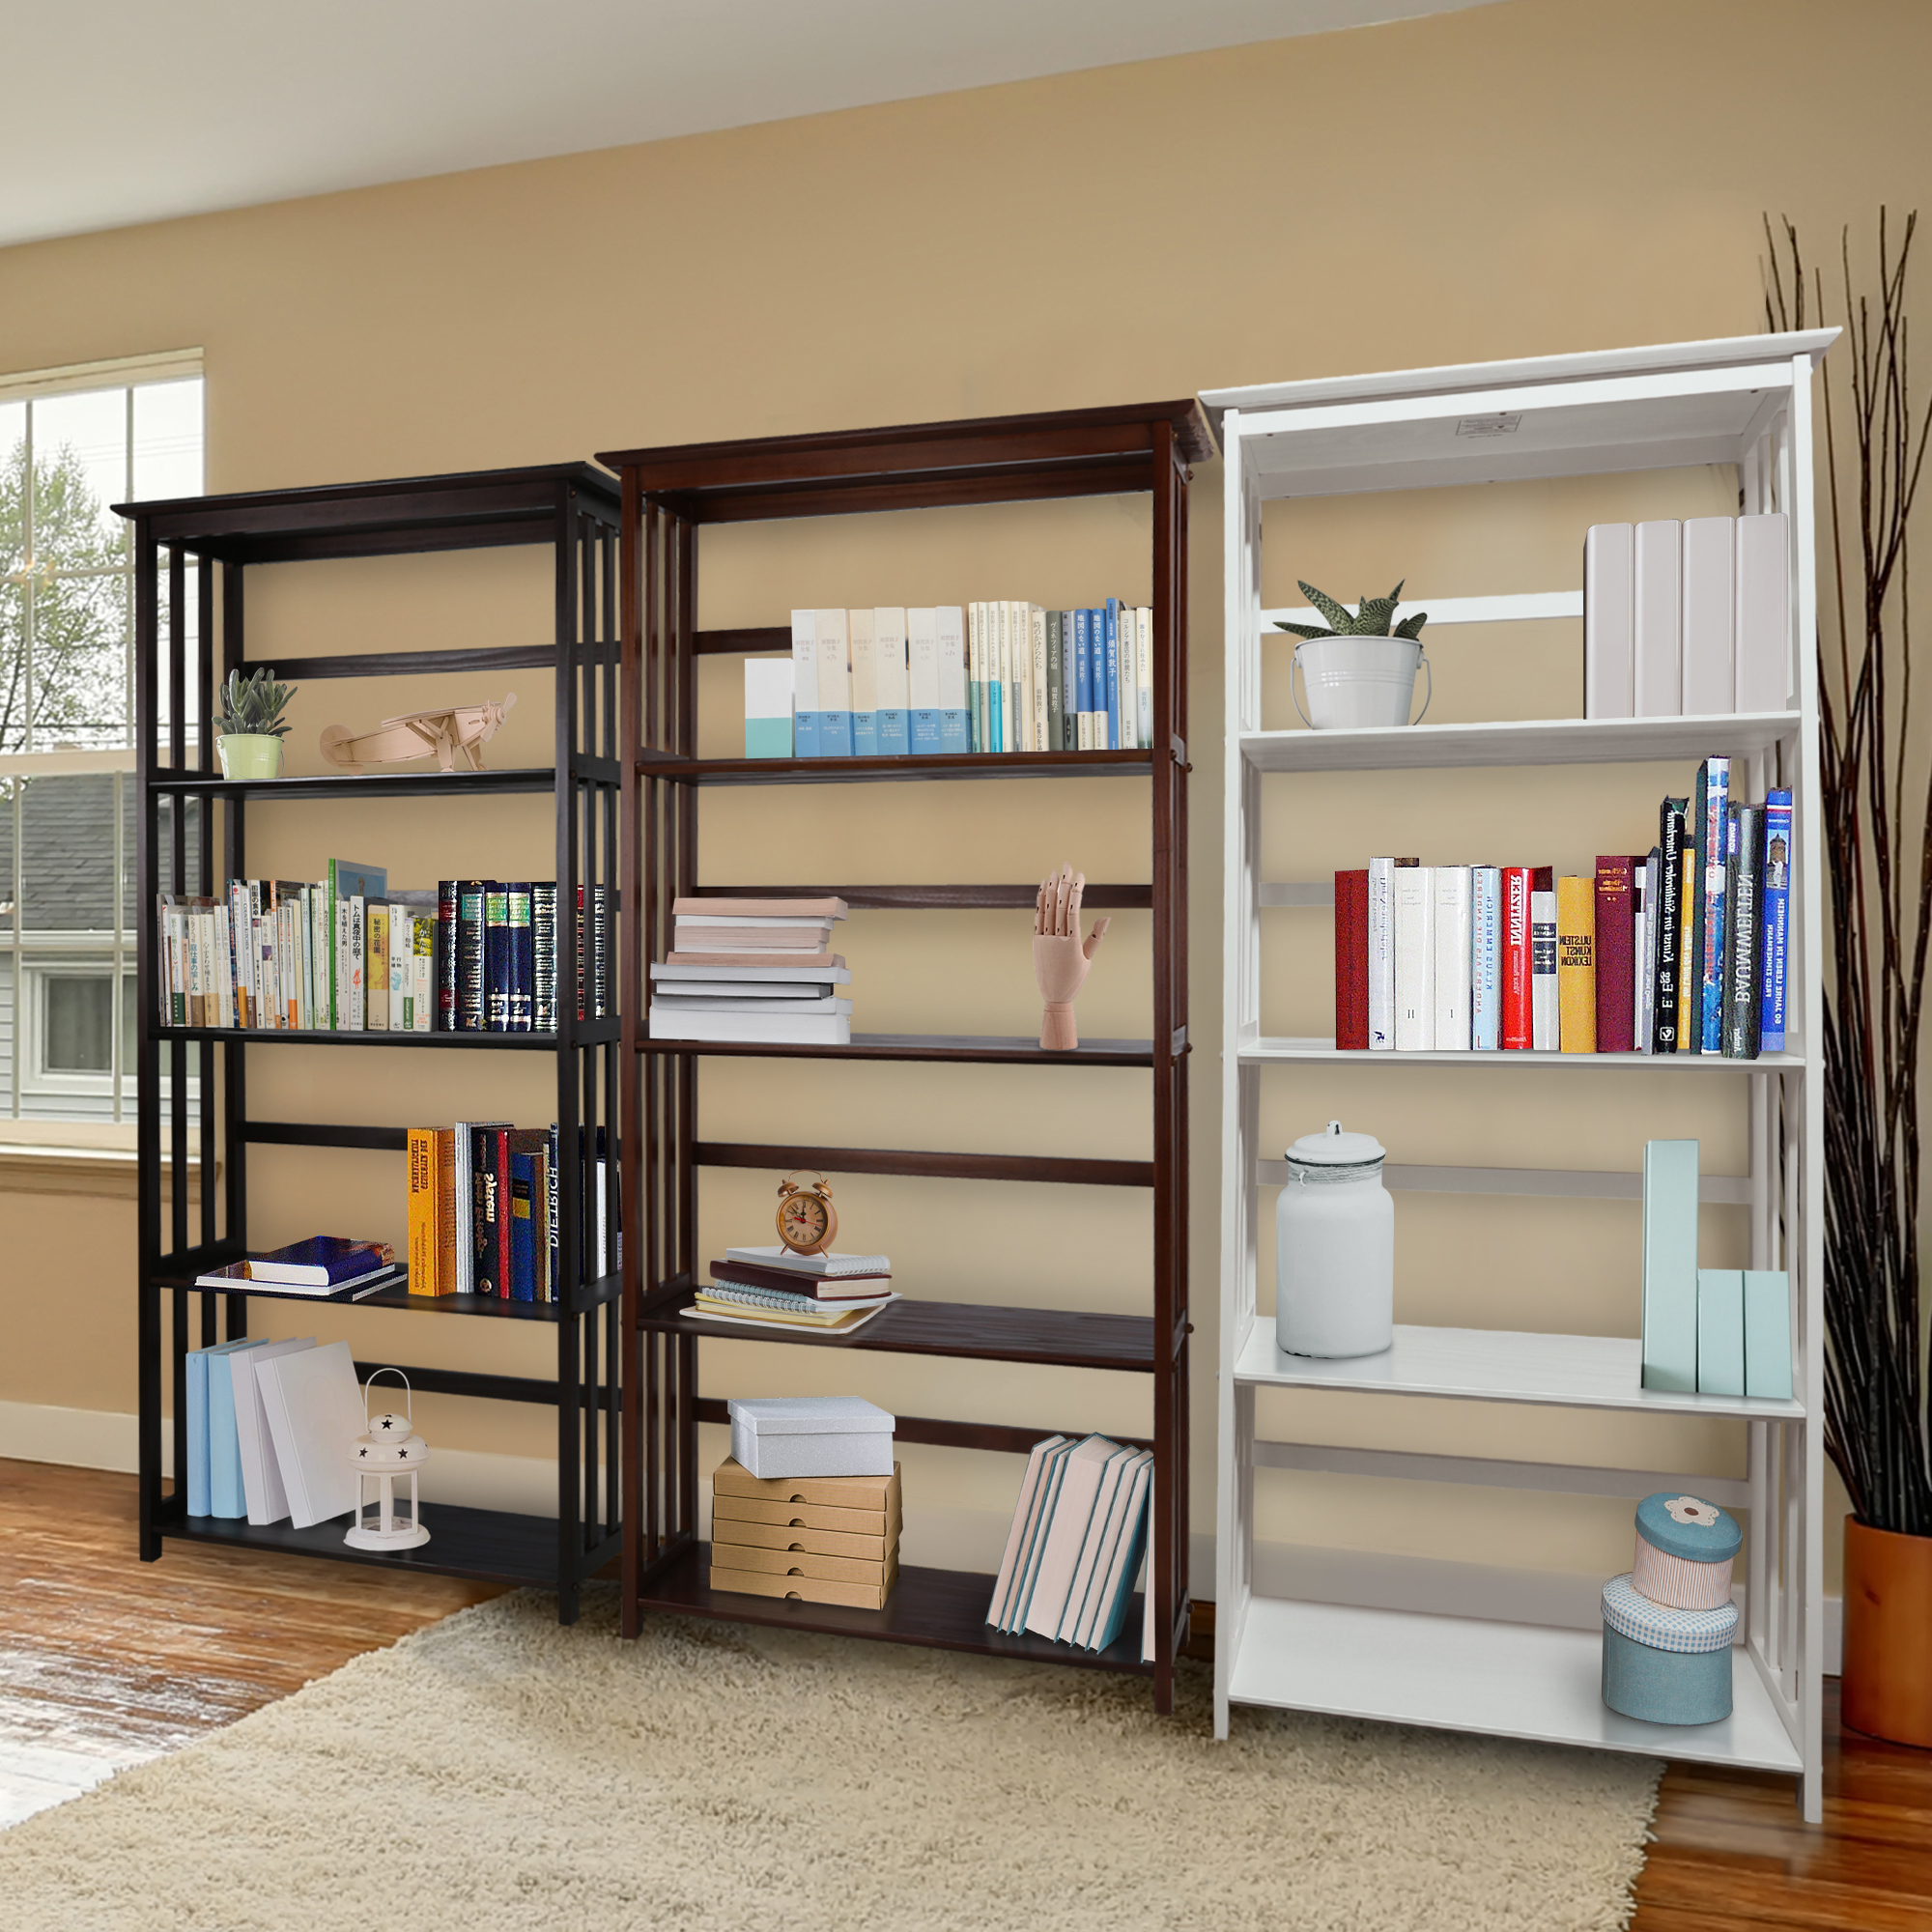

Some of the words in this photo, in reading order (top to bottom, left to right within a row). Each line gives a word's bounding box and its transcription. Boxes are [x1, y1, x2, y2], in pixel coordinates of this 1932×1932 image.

[1034, 621, 1042, 670] 時のかけらたち
[1077, 614, 1086, 655] 地図のない道
[353, 904, 362, 960] トムは真夜中の庭で
